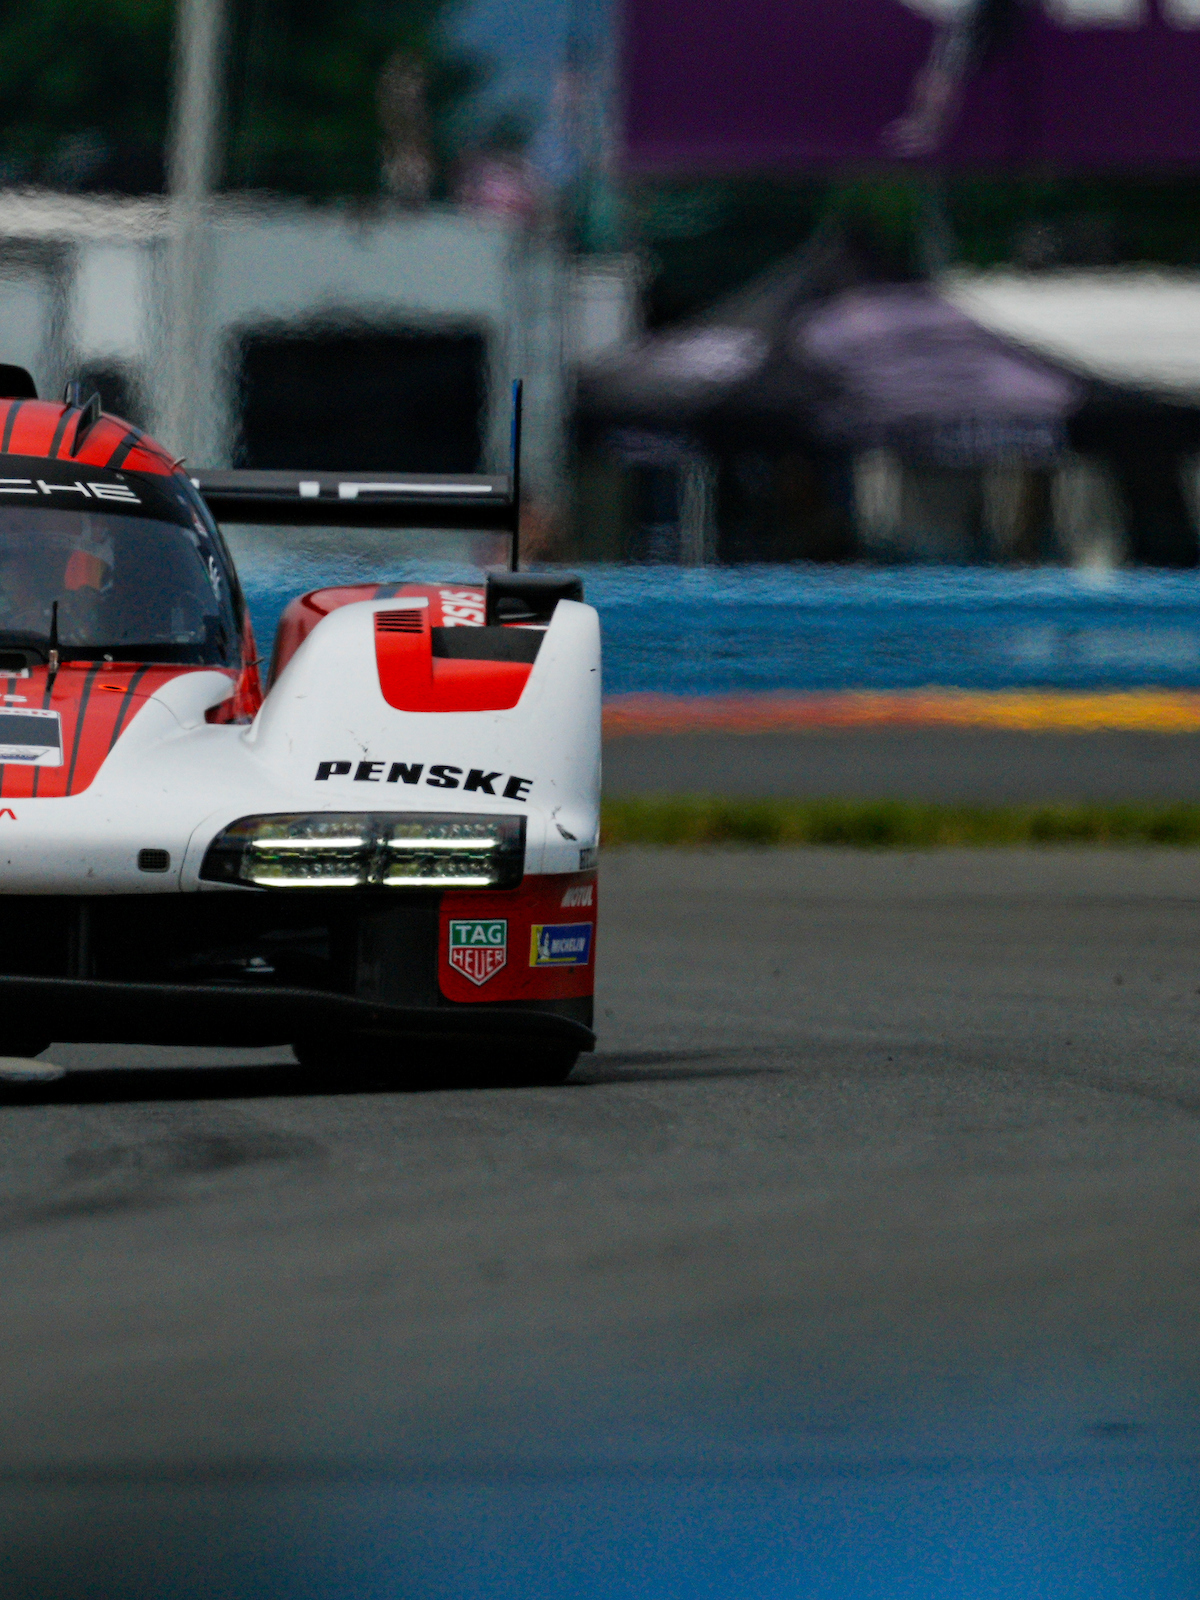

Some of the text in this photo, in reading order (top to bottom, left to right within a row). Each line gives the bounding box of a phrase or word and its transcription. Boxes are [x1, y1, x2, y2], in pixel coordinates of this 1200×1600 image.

[314, 760, 534, 802] PENSKE
[455, 925, 502, 944] TAG
[452, 949, 503, 980] HEUER
